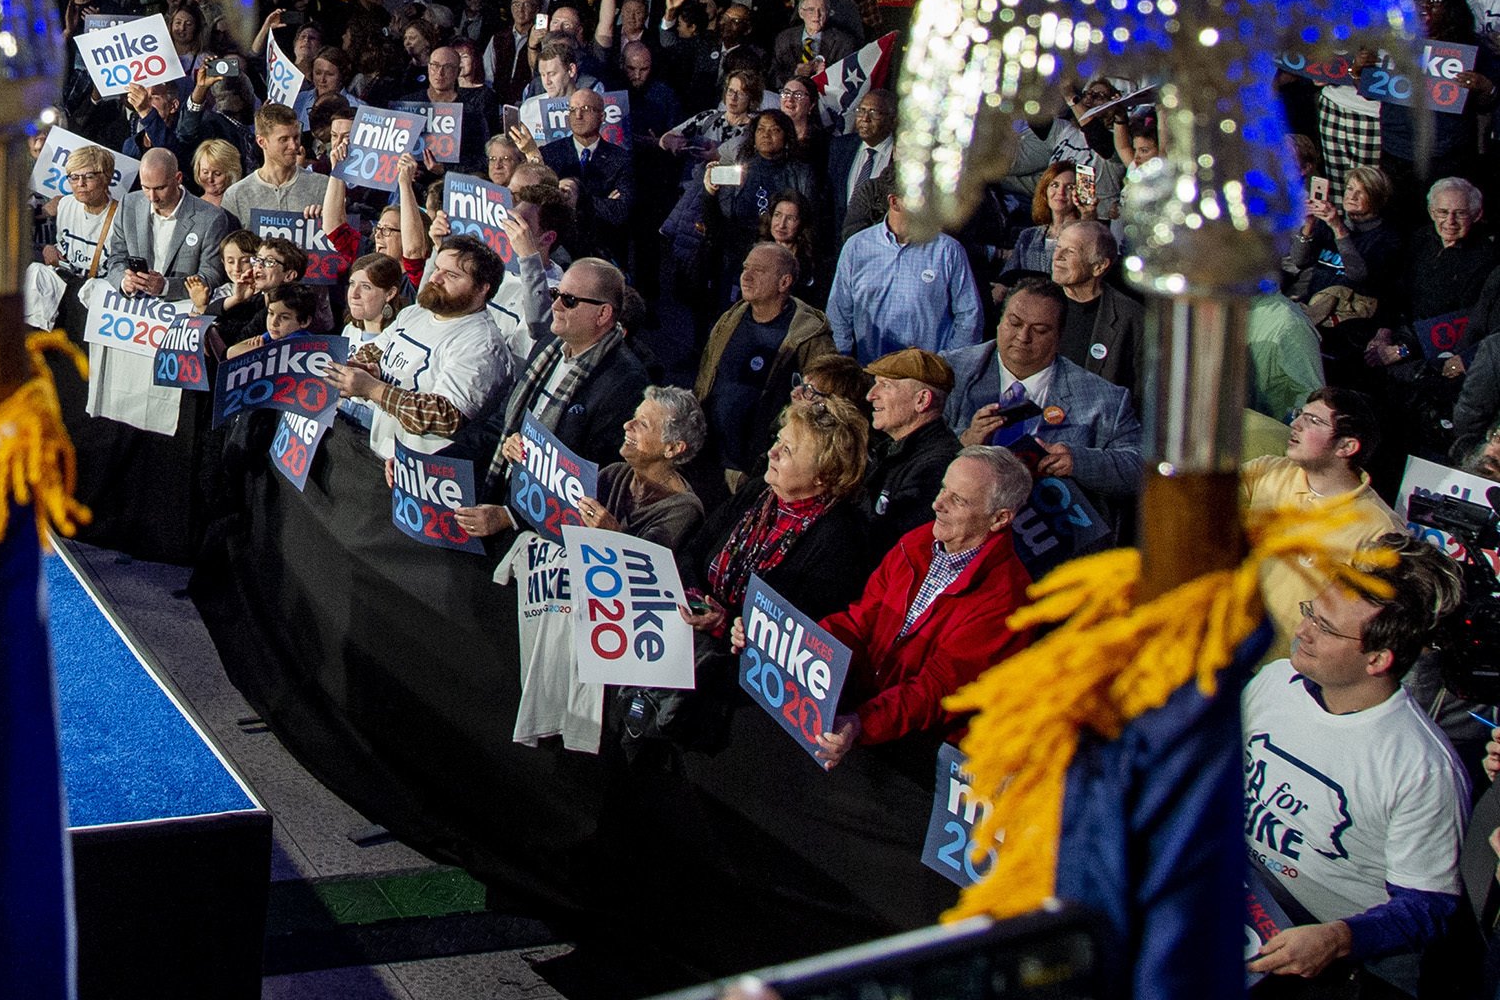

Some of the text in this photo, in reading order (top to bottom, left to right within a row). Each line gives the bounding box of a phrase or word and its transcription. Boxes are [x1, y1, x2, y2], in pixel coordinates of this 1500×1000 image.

[91, 32, 159, 66] mike
[101, 55, 167, 88] 2020
[353, 116, 410, 154] mike
[343, 148, 400, 184] 2020
[450, 180, 474, 192] PHILLY
[260, 215, 293, 226] PHILLY
[448, 185, 509, 231] mike
[103, 289, 177, 323] mike
[98, 313, 169, 350] 2020
[161, 318, 200, 353] mike
[158, 352, 202, 384] 2020
[225, 344, 333, 392] mike
[389, 351, 409, 370] for
[223, 377, 329, 418] 2020
[273, 422, 308, 477] 2020
[524, 424, 546, 446] PHILLY
[426, 464, 456, 479] LIKES
[521, 435, 585, 509] mike
[558, 453, 581, 477] LIKES
[393, 456, 463, 510] mike
[394, 489, 470, 545] 2020
[548, 604, 572, 615] 2020
[580, 543, 628, 661] 2020
[622, 548, 678, 663] mike
[754, 590, 785, 622] PHILLY
[747, 605, 832, 701] mike
[805, 631, 834, 663] LIKES
[746, 647, 823, 745] 2020
[1262, 781, 1309, 817] for
[1266, 858, 1298, 879] 2020
